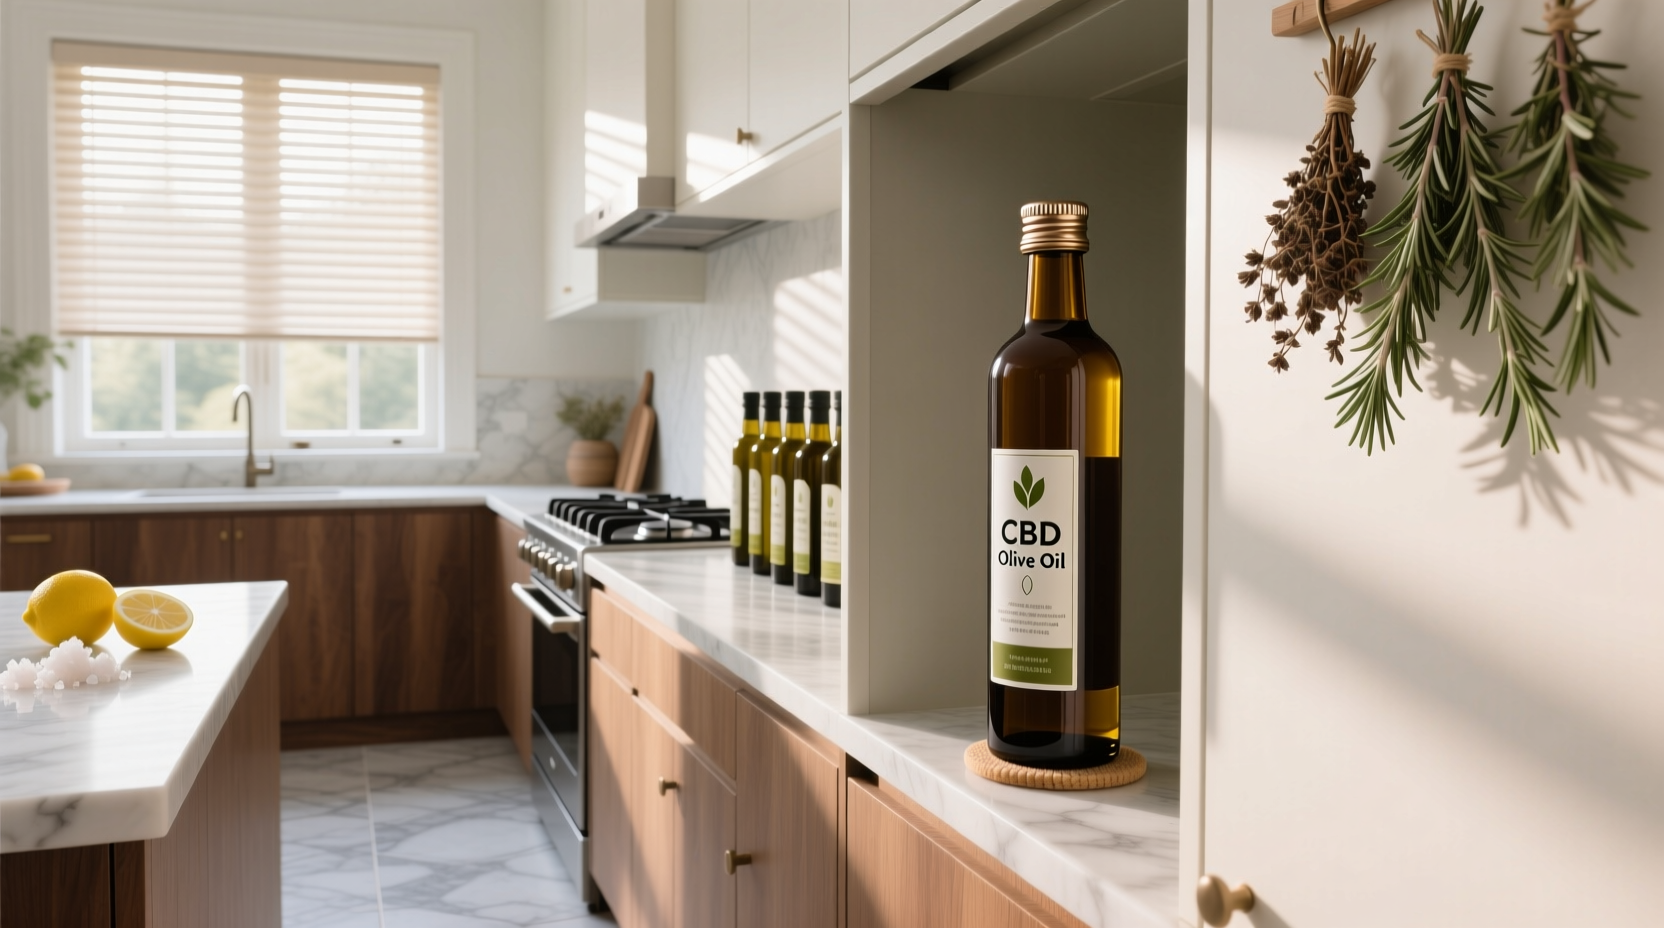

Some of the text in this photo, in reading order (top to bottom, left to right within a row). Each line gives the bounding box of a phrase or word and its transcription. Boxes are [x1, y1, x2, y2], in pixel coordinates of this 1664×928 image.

[1001, 519, 1061, 547] CBD
[998, 549, 1066, 569] Olive Oil
